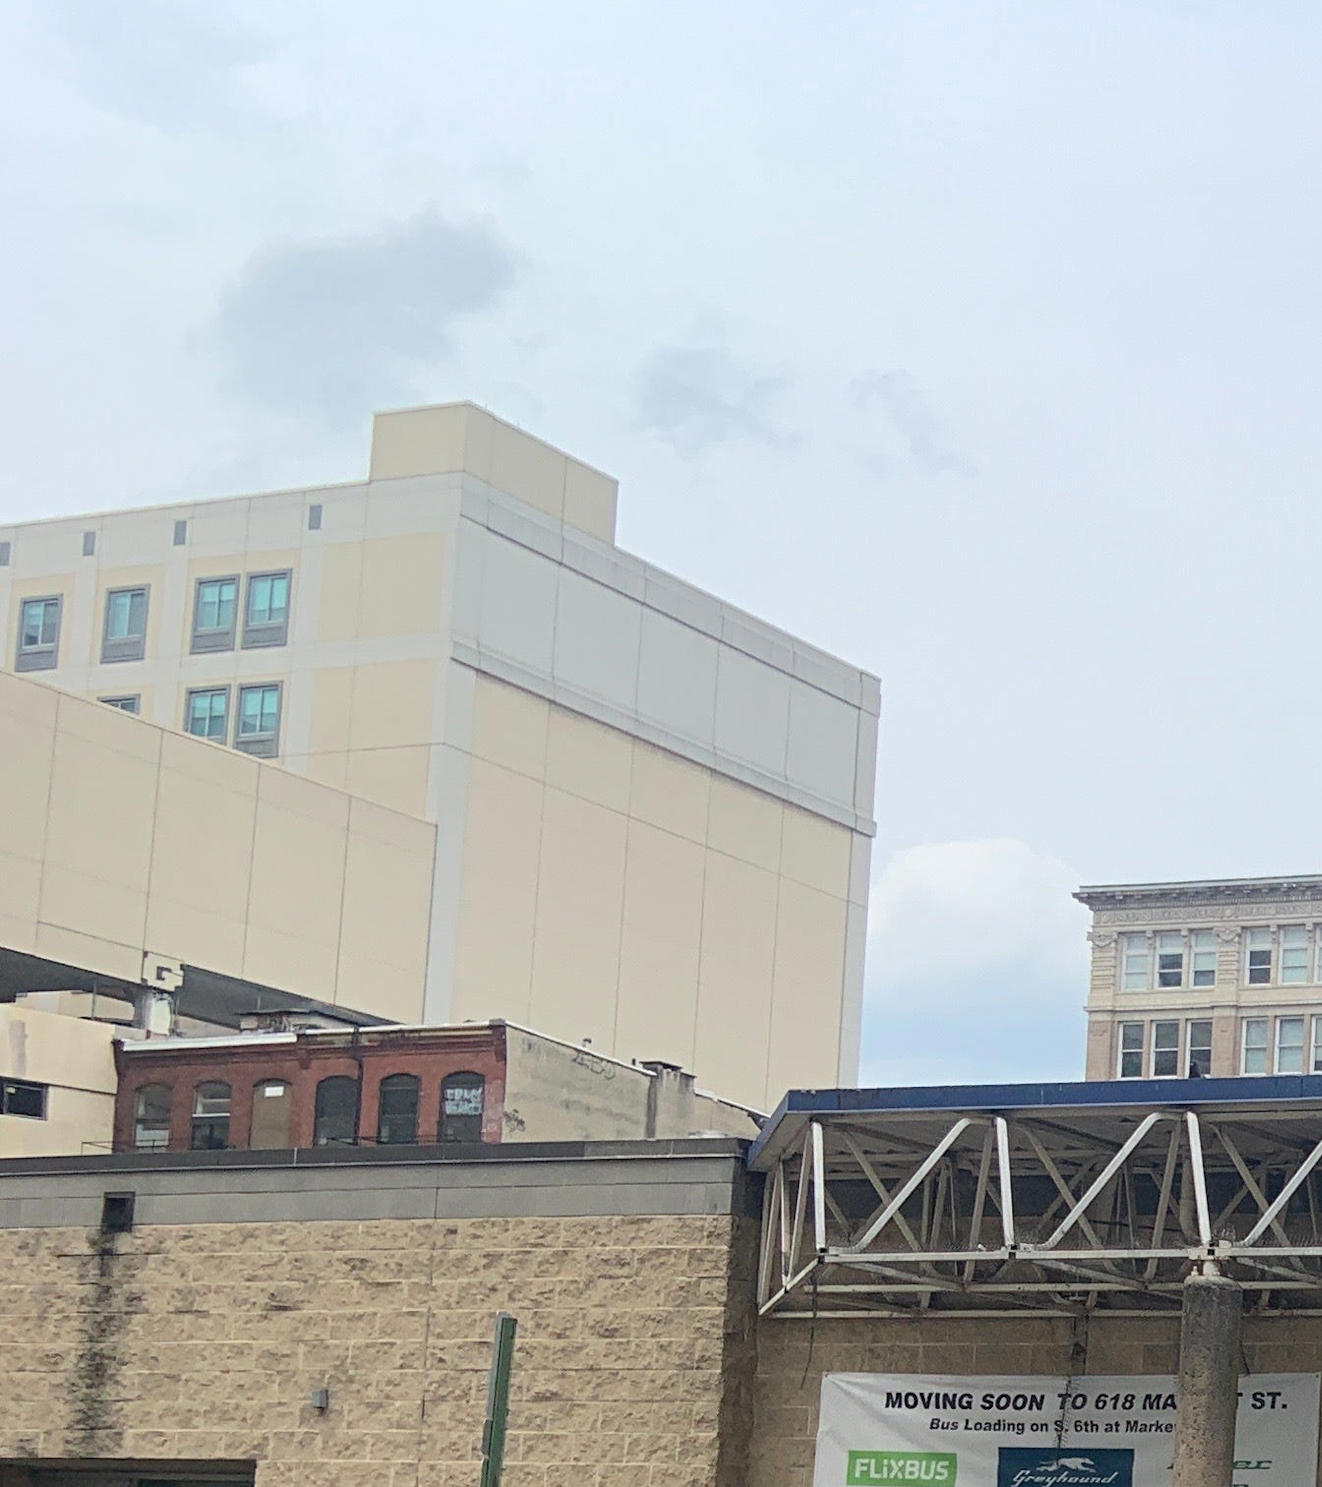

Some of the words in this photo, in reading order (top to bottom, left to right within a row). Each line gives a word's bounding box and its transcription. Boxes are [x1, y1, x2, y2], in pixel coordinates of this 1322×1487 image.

[885, 1392, 973, 1410] MOVING
[980, 1393, 1045, 1411] SOON
[1058, 1393, 1088, 1410] TO
[1095, 1393, 1136, 1411] 618
[1251, 1392, 1287, 1409] ST.
[930, 1418, 959, 1430] Bus
[964, 1419, 1025, 1435] Loading
[1030, 1423, 1048, 1432] on
[1054, 1420, 1069, 1433] S.
[1074, 1420, 1099, 1433] 6th
[1104, 1422, 1120, 1433] at
[1125, 1420, 1177, 1433] Marke
[1011, 1470, 1119, 1487] Greyhound
